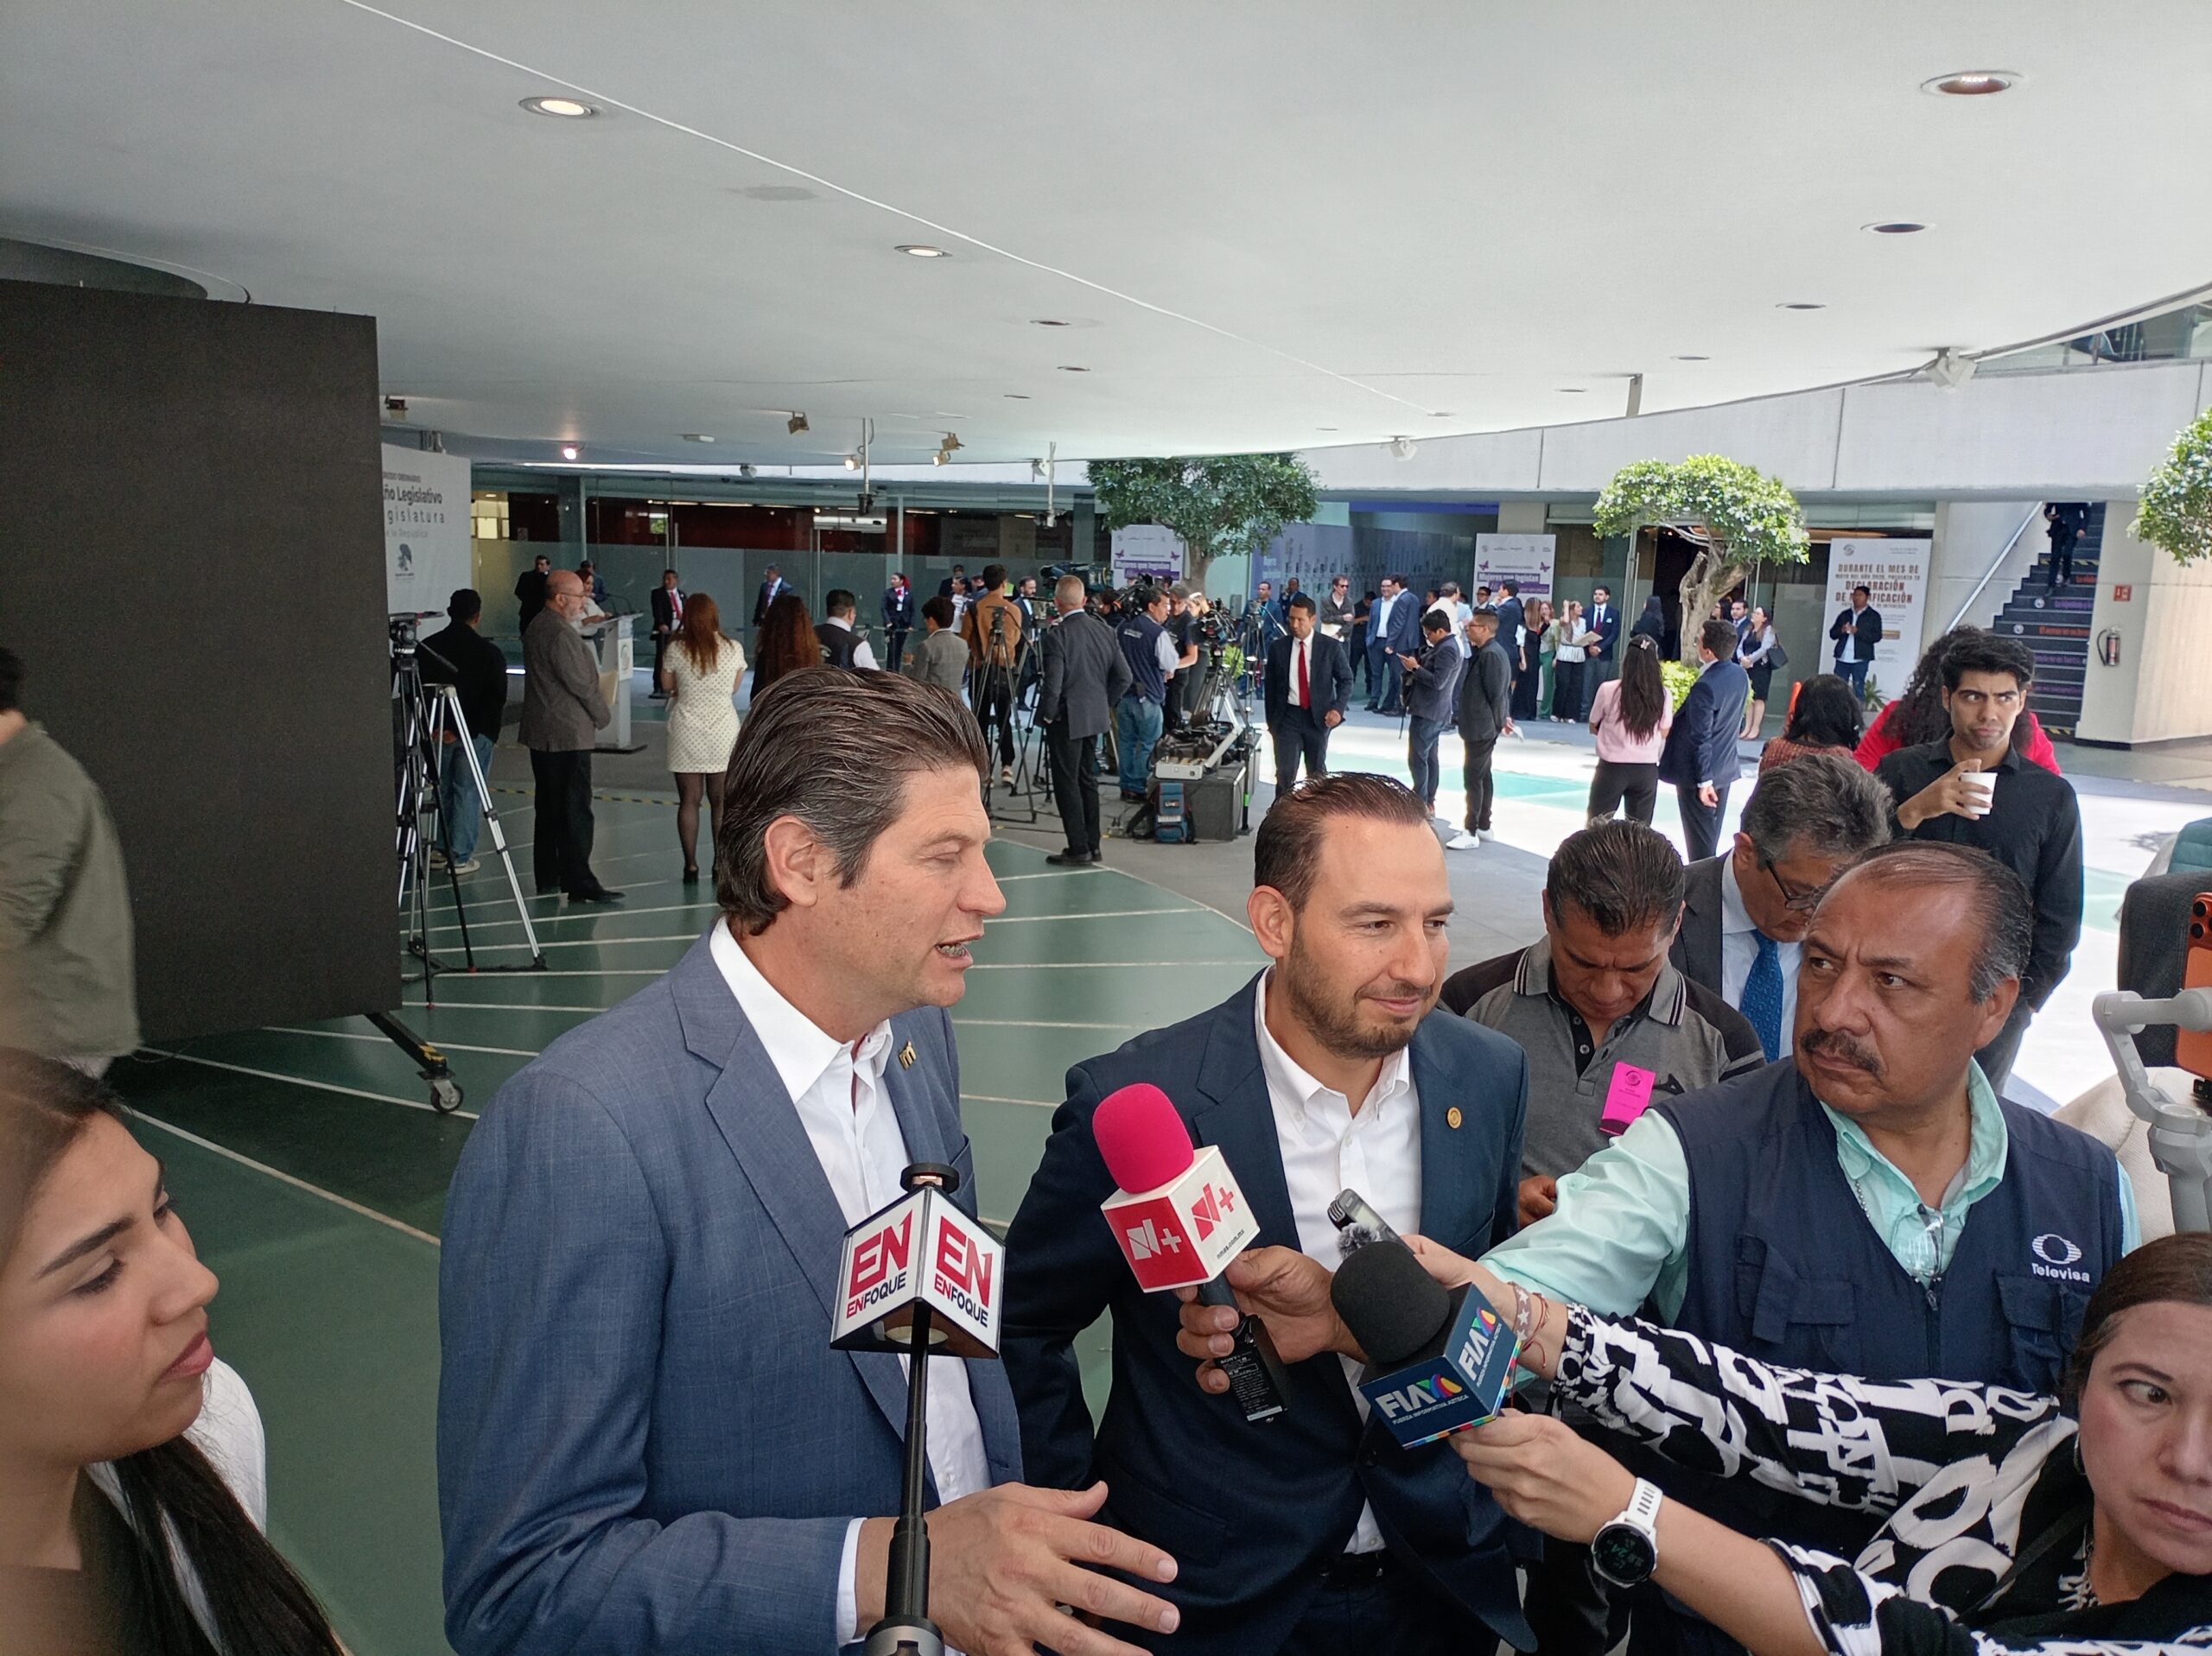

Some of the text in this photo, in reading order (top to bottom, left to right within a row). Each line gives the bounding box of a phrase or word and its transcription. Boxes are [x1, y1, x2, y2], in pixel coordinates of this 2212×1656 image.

[384, 484, 442, 506] ño Legislativo
[387, 505, 445, 524] gislatura
[1838, 564, 1920, 574] DURANTE EL MES DE
[1835, 592, 1847, 601] DE
[1192, 1183, 1234, 1242] N+
[849, 1209, 912, 1299] EN
[1126, 1219, 1181, 1260] N+
[936, 1215, 993, 1308] EN
[2031, 1263, 2090, 1283] Televisa
[847, 1272, 906, 1319] ENFOQUE
[934, 1273, 988, 1328] ENFOQUE
[1458, 1328, 1489, 1380] FIA
[1375, 1384, 1437, 1418] FIA
